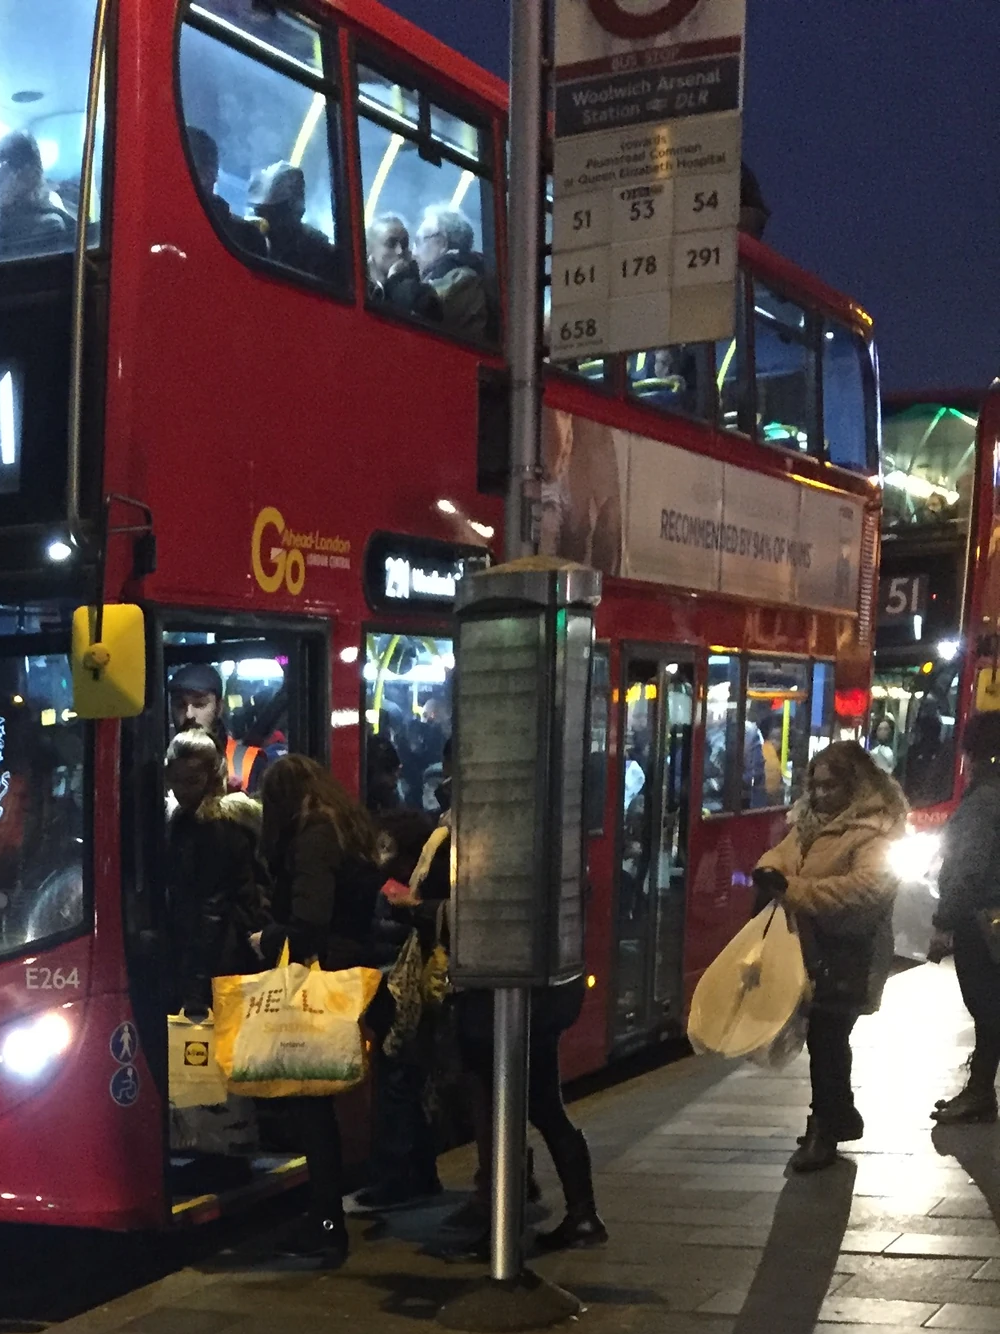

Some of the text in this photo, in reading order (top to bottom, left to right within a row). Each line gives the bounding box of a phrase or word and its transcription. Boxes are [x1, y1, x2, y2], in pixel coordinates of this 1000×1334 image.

[572, 68, 721, 107] Woolwich Arsenal
[583, 90, 710, 126] Station DLR
[578, 171, 616, 185] Queen
[676, 152, 726, 169] Hospital
[572, 190, 719, 231] 51 53 54
[564, 247, 720, 286] 161 178 291
[560, 318, 597, 341] 658
[251, 506, 306, 596] Go
[885, 577, 918, 615] 51
[26, 967, 80, 989] E264
